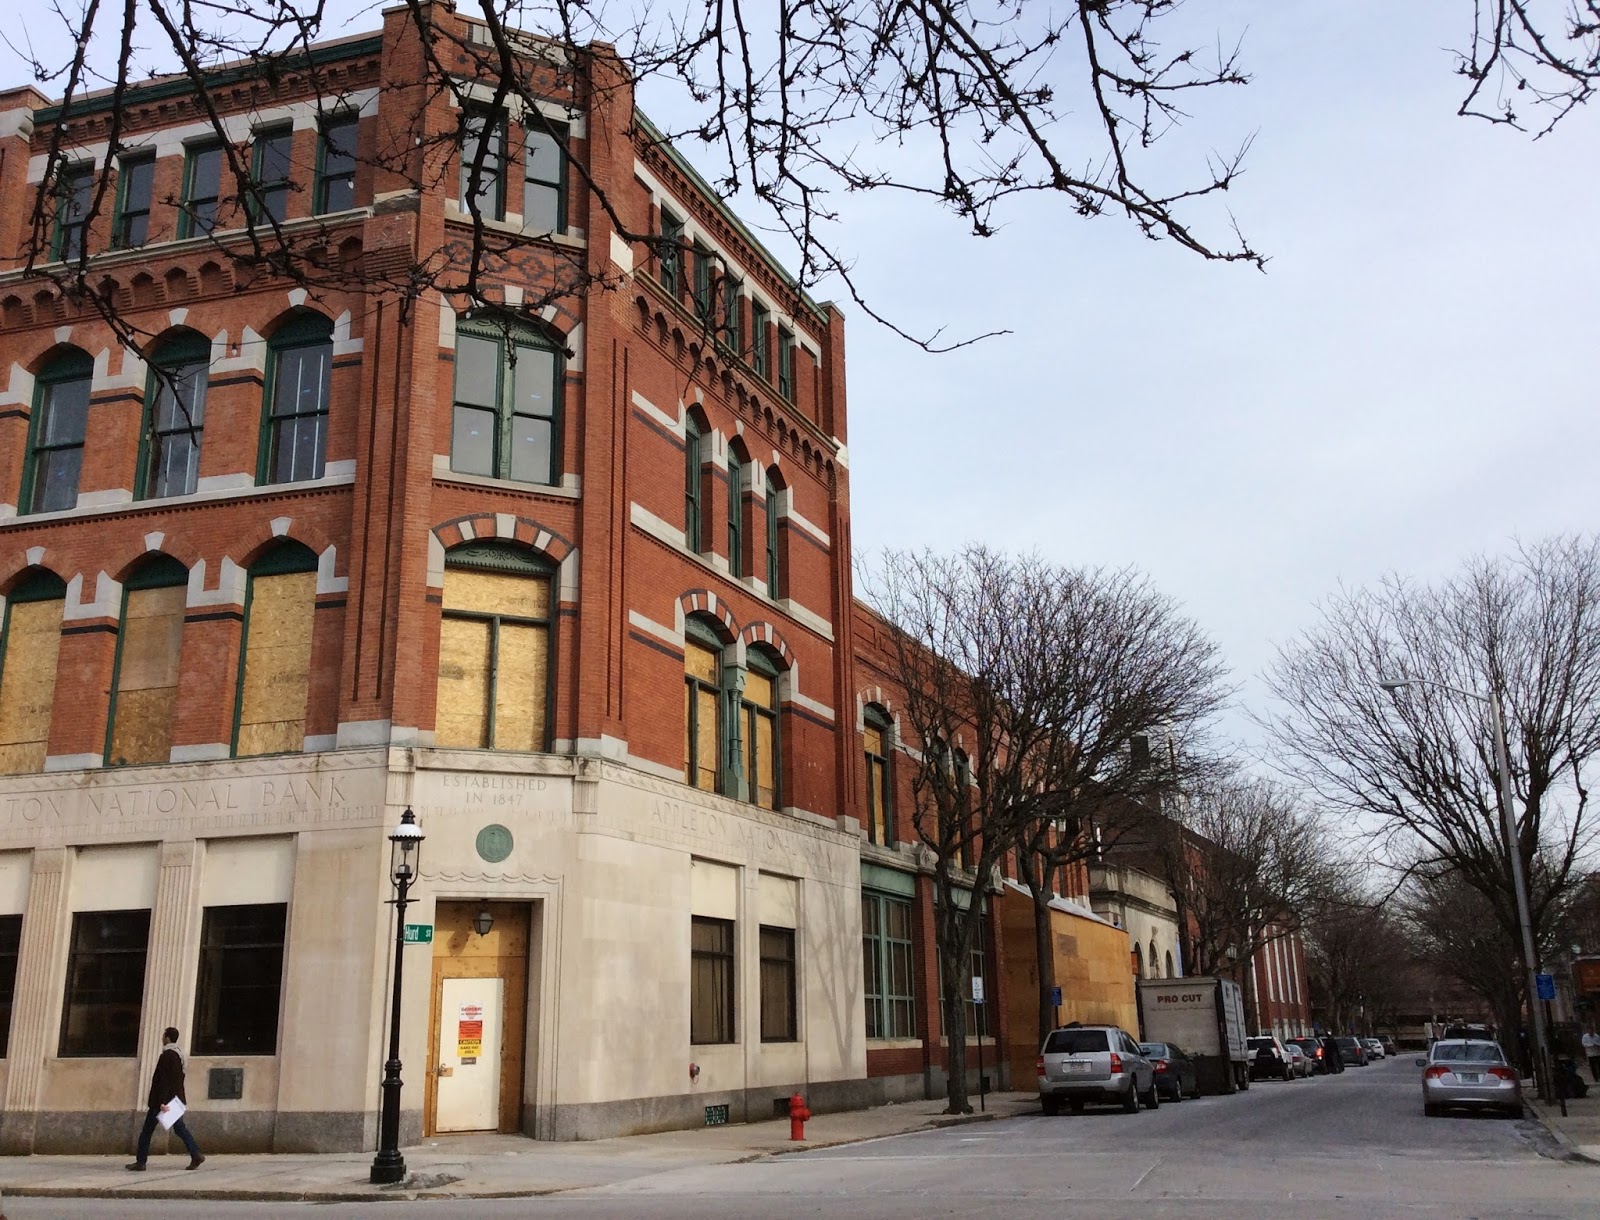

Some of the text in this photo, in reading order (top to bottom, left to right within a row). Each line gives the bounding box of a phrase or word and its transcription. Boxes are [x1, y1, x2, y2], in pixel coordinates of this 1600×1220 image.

[443, 775, 547, 791] ESTABLISHED
[86, 784, 239, 818] NATIONAL
[262, 776, 346, 806] BANK
[466, 791, 523, 806] IN 1847
[652, 801, 727, 838] APPLETON
[404, 925, 420, 941] Hurd
[1157, 994, 1202, 1003] PRO CUT
